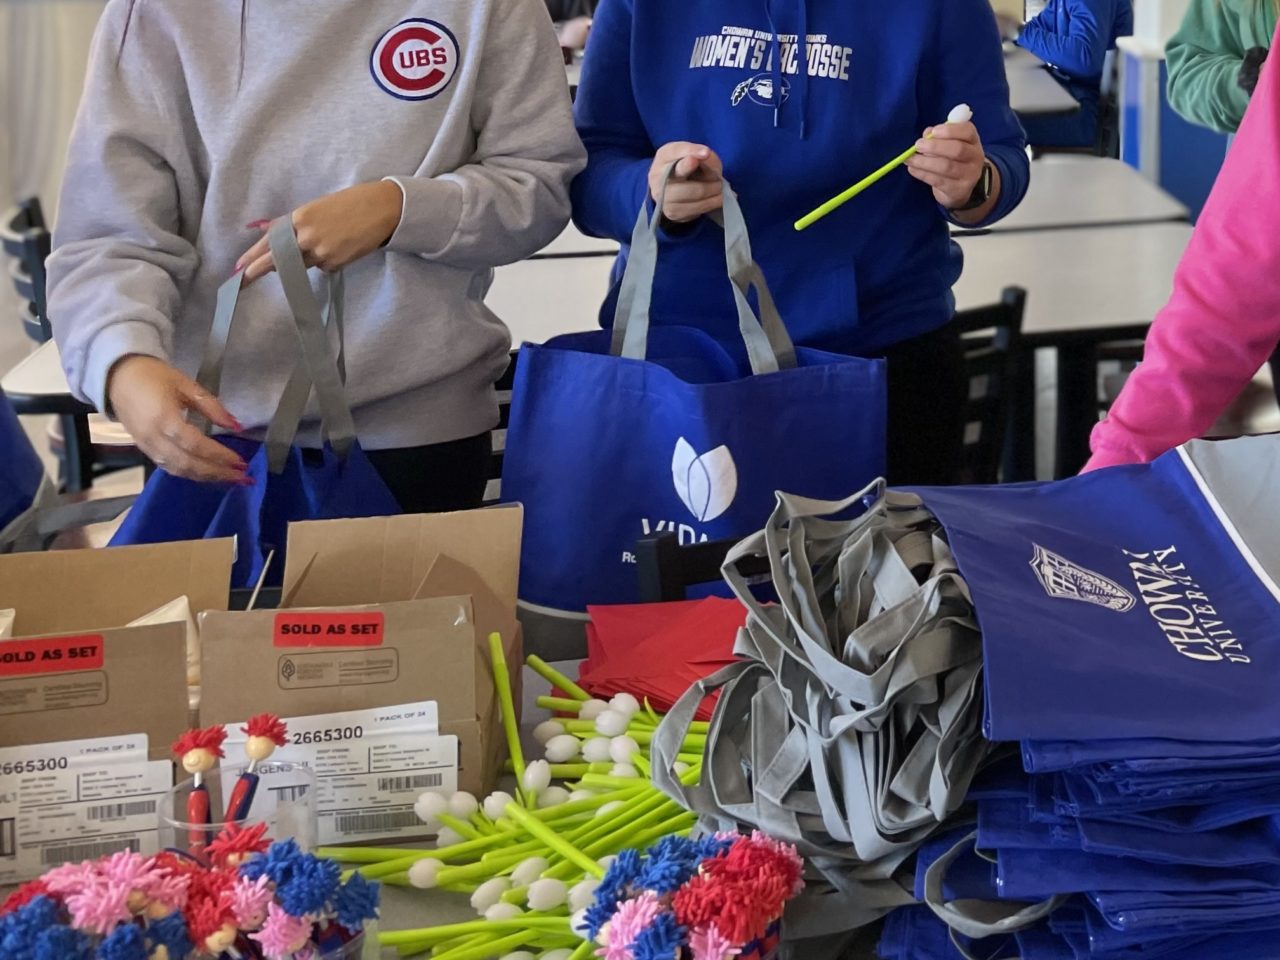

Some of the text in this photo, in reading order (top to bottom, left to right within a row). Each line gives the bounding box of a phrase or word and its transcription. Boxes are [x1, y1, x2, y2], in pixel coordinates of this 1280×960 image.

[754, 30, 798, 43] UNIVRSITY
[689, 35, 852, 81] WOMEN'S LACOSSE
[281, 623, 379, 635] SOLD AS SET
[41, 649, 63, 661] AS
[68, 646, 98, 659] SET
[379, 714, 402, 722] PACK
[293, 726, 363, 745] 2665300
